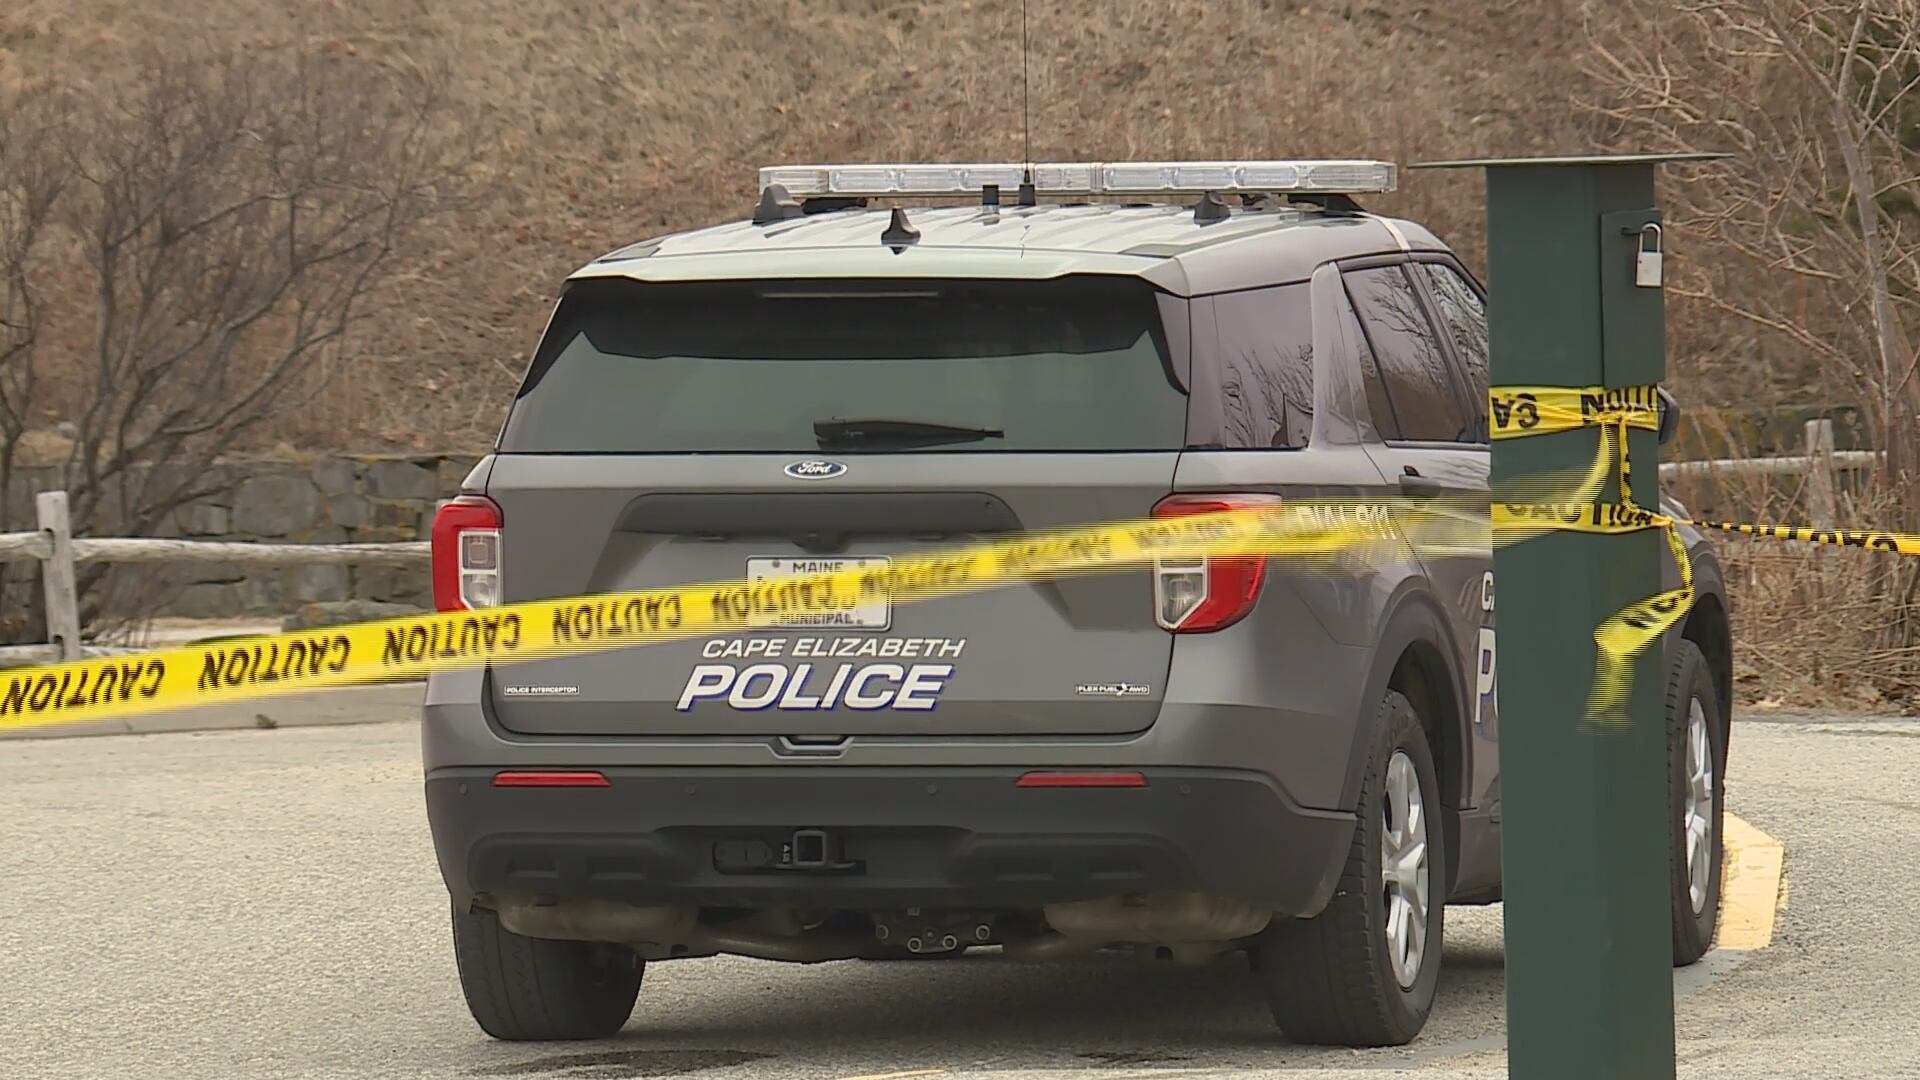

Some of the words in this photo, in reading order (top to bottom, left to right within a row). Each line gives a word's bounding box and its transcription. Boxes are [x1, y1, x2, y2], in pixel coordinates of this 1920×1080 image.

[798, 461, 832, 474] Ford
[1355, 504, 1396, 540] 911
[793, 562, 844, 573] MAINE
[552, 593, 681, 645] CAUTION
[711, 576, 834, 622] CAUTION
[780, 613, 854, 625] MUNICIPAL
[382, 613, 521, 667] CAUTION
[702, 639, 786, 659] CAPE
[791, 637, 967, 658] ELIZABETH
[198, 635, 352, 692] CAUTION
[1474, 627, 1498, 723] P
[0, 659, 165, 716] CAUTION
[506, 686, 529, 694] POLICE
[530, 686, 577, 694] INTERCEPTOR
[676, 663, 953, 711] POLICE
